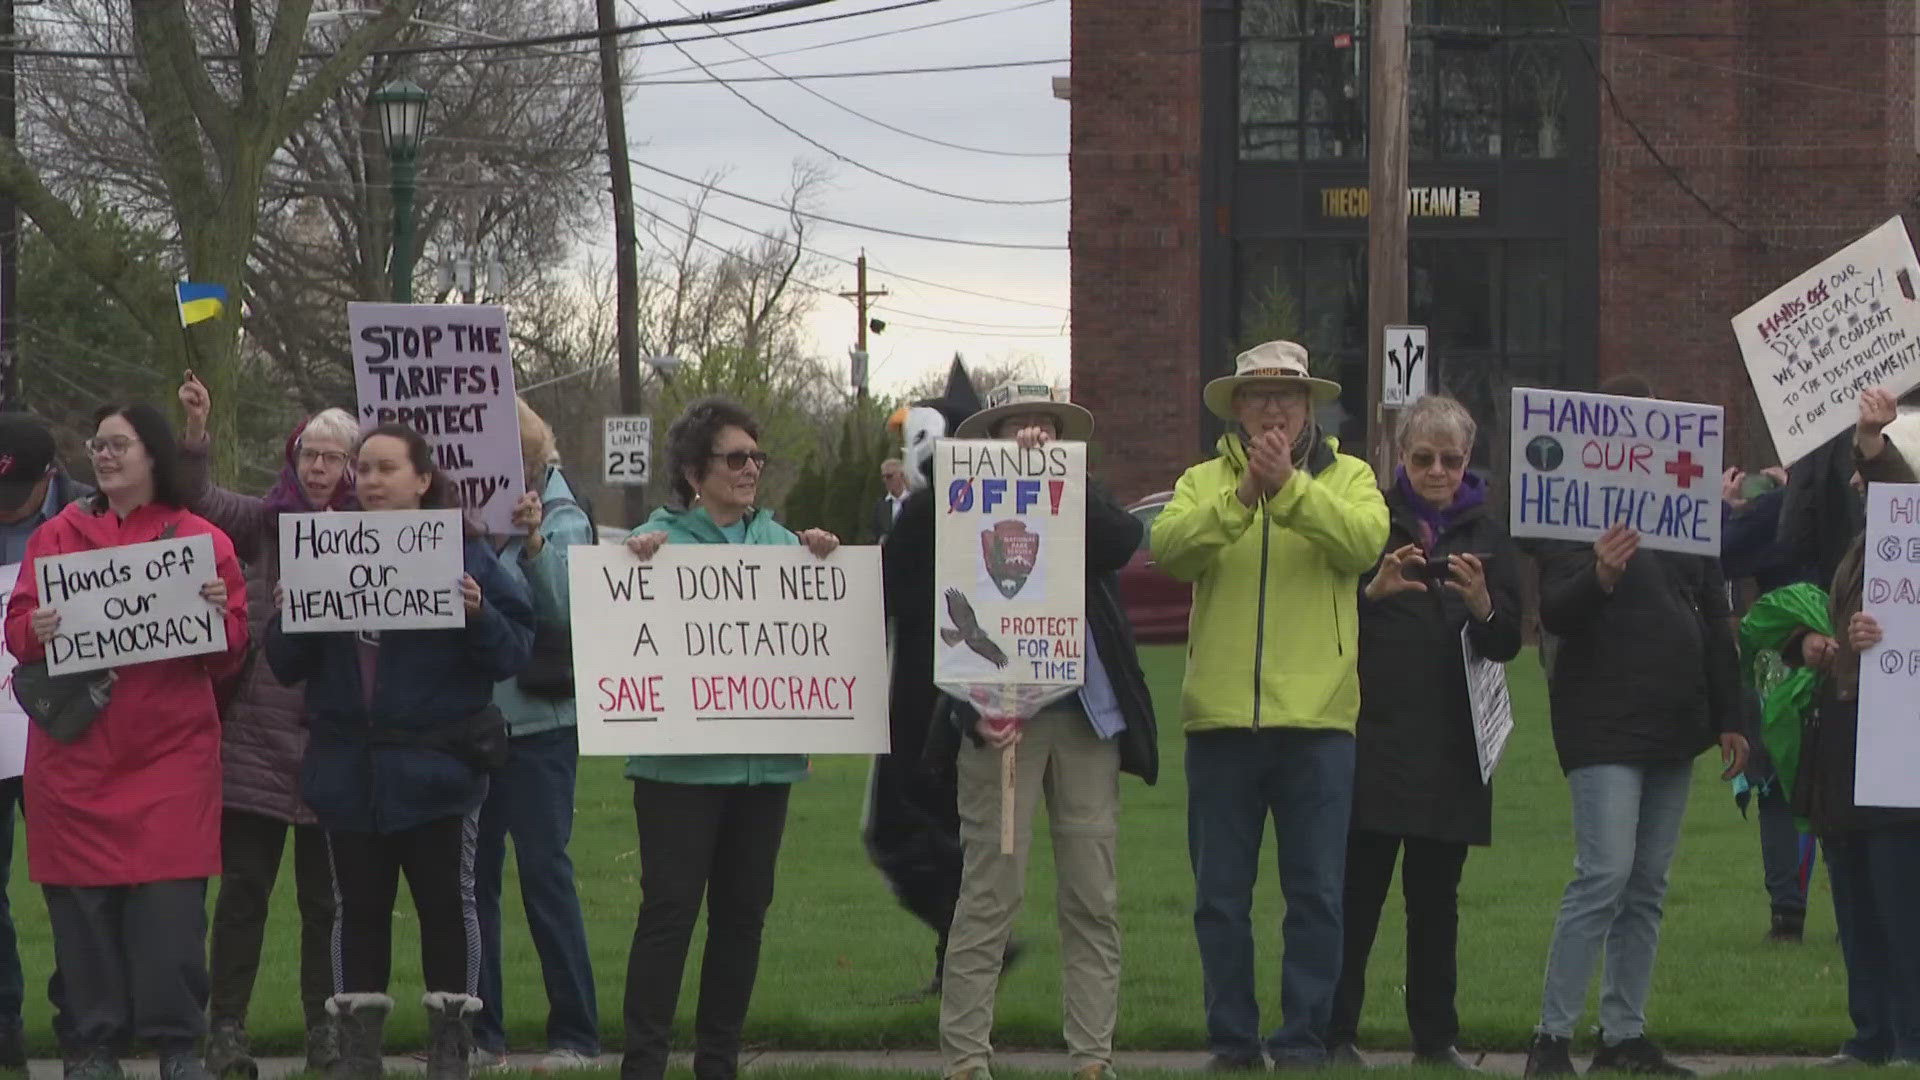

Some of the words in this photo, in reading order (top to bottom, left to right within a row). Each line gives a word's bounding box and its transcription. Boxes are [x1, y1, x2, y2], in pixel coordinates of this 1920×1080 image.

[1757, 296, 1806, 339] HANDS
[1807, 278, 1830, 304] OFF
[1831, 264, 1861, 288] OUR
[1770, 267, 1885, 357] DEMOCRACY!
[361, 325, 443, 364] STOP
[448, 324, 502, 354] THE
[1773, 367, 1796, 386] WE
[1839, 307, 1893, 350] CONSENT
[369, 365, 500, 401] TARIFFS!
[1783, 392, 1800, 406] TO
[1800, 378, 1821, 394] THE
[608, 421, 648, 432] SPEED
[1522, 394, 1637, 438] HANDS
[1645, 409, 1719, 448] OFF
[612, 434, 643, 446] LIMIT
[1582, 439, 1654, 474] OUR
[609, 451, 645, 476] 25
[952, 446, 1067, 477] HANDS
[1520, 473, 1711, 542] HEALTHCARE
[1890, 497, 1920, 524] H
[294, 518, 380, 560] Hands
[43, 559, 131, 605] Hands
[146, 546, 195, 580] off
[603, 565, 655, 601] WE
[676, 559, 761, 601] DON'T
[780, 565, 847, 601] NEED
[289, 588, 454, 623] HEALTHCARE
[50, 610, 213, 665] DEMOCRACY
[633, 622, 659, 656] A
[685, 621, 831, 656] DICTATOR
[1001, 616, 1078, 637] PROTECT
[1018, 638, 1048, 658] FOR
[1053, 640, 1081, 658] ALL
[1031, 661, 1077, 680] TIME
[598, 675, 665, 712] SAVE
[691, 675, 857, 711] DEMOCRACY
